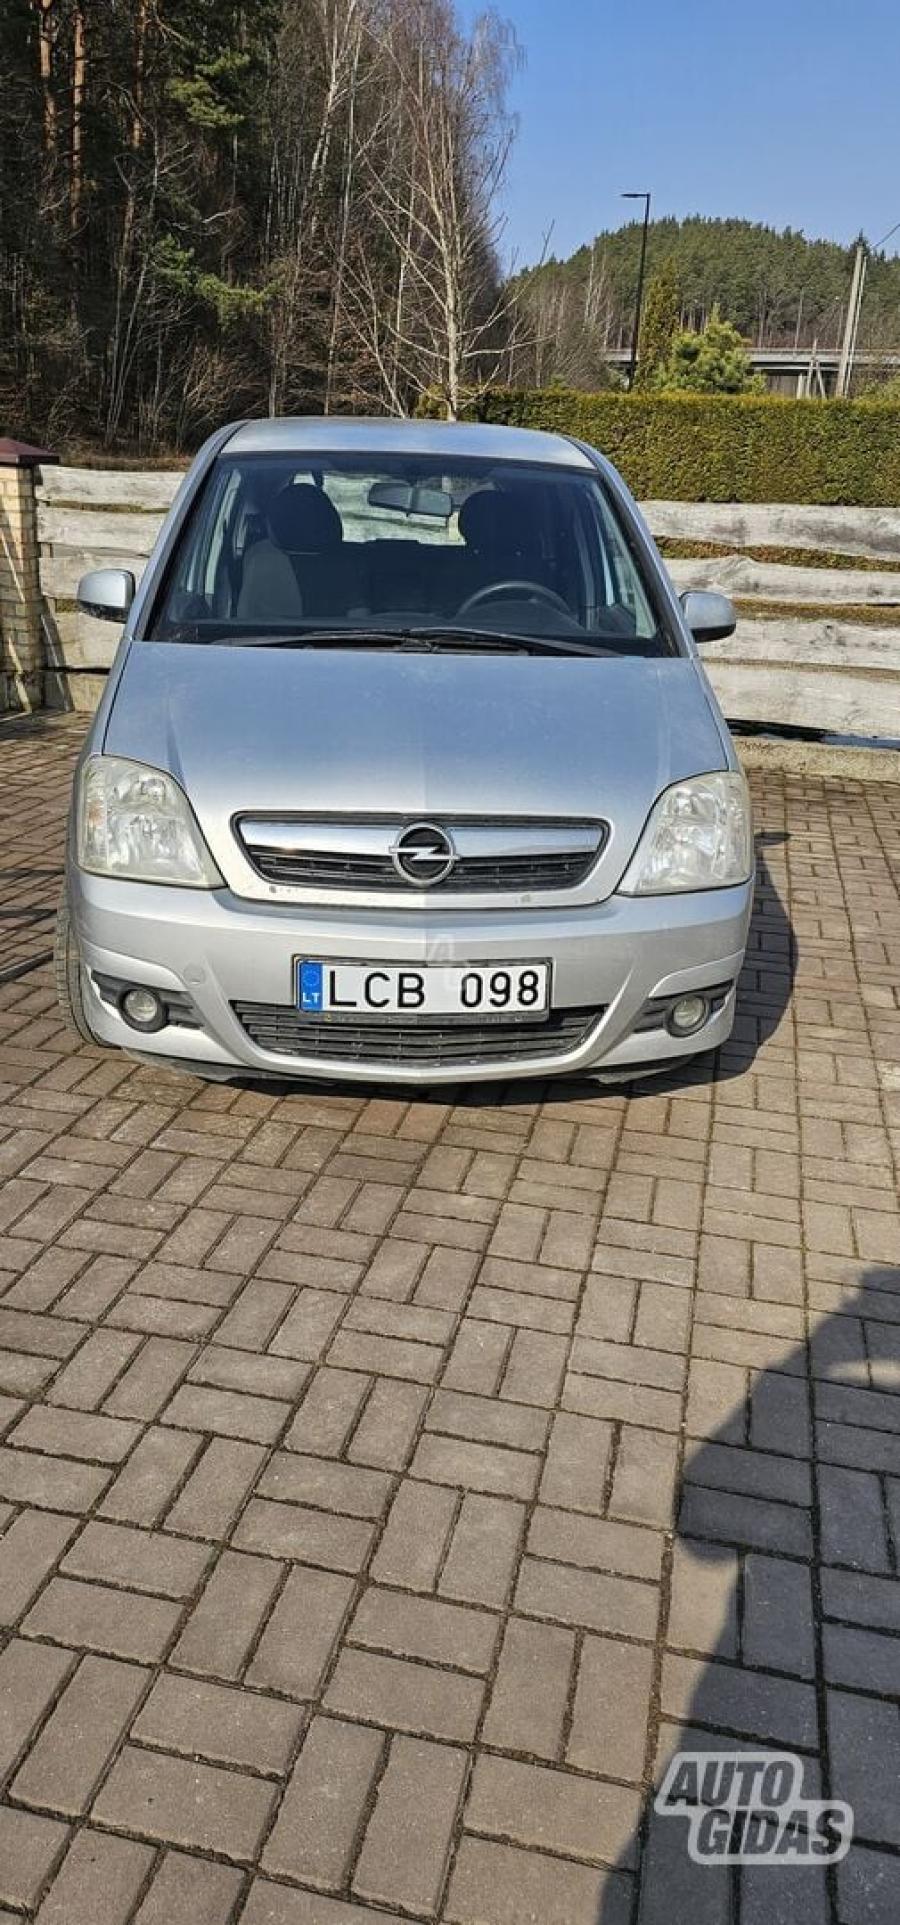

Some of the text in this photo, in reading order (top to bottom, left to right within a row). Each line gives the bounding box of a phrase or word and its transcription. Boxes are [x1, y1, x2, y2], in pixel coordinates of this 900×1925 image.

[302, 992, 321, 1004] LT
[329, 970, 540, 1008] LCB 098
